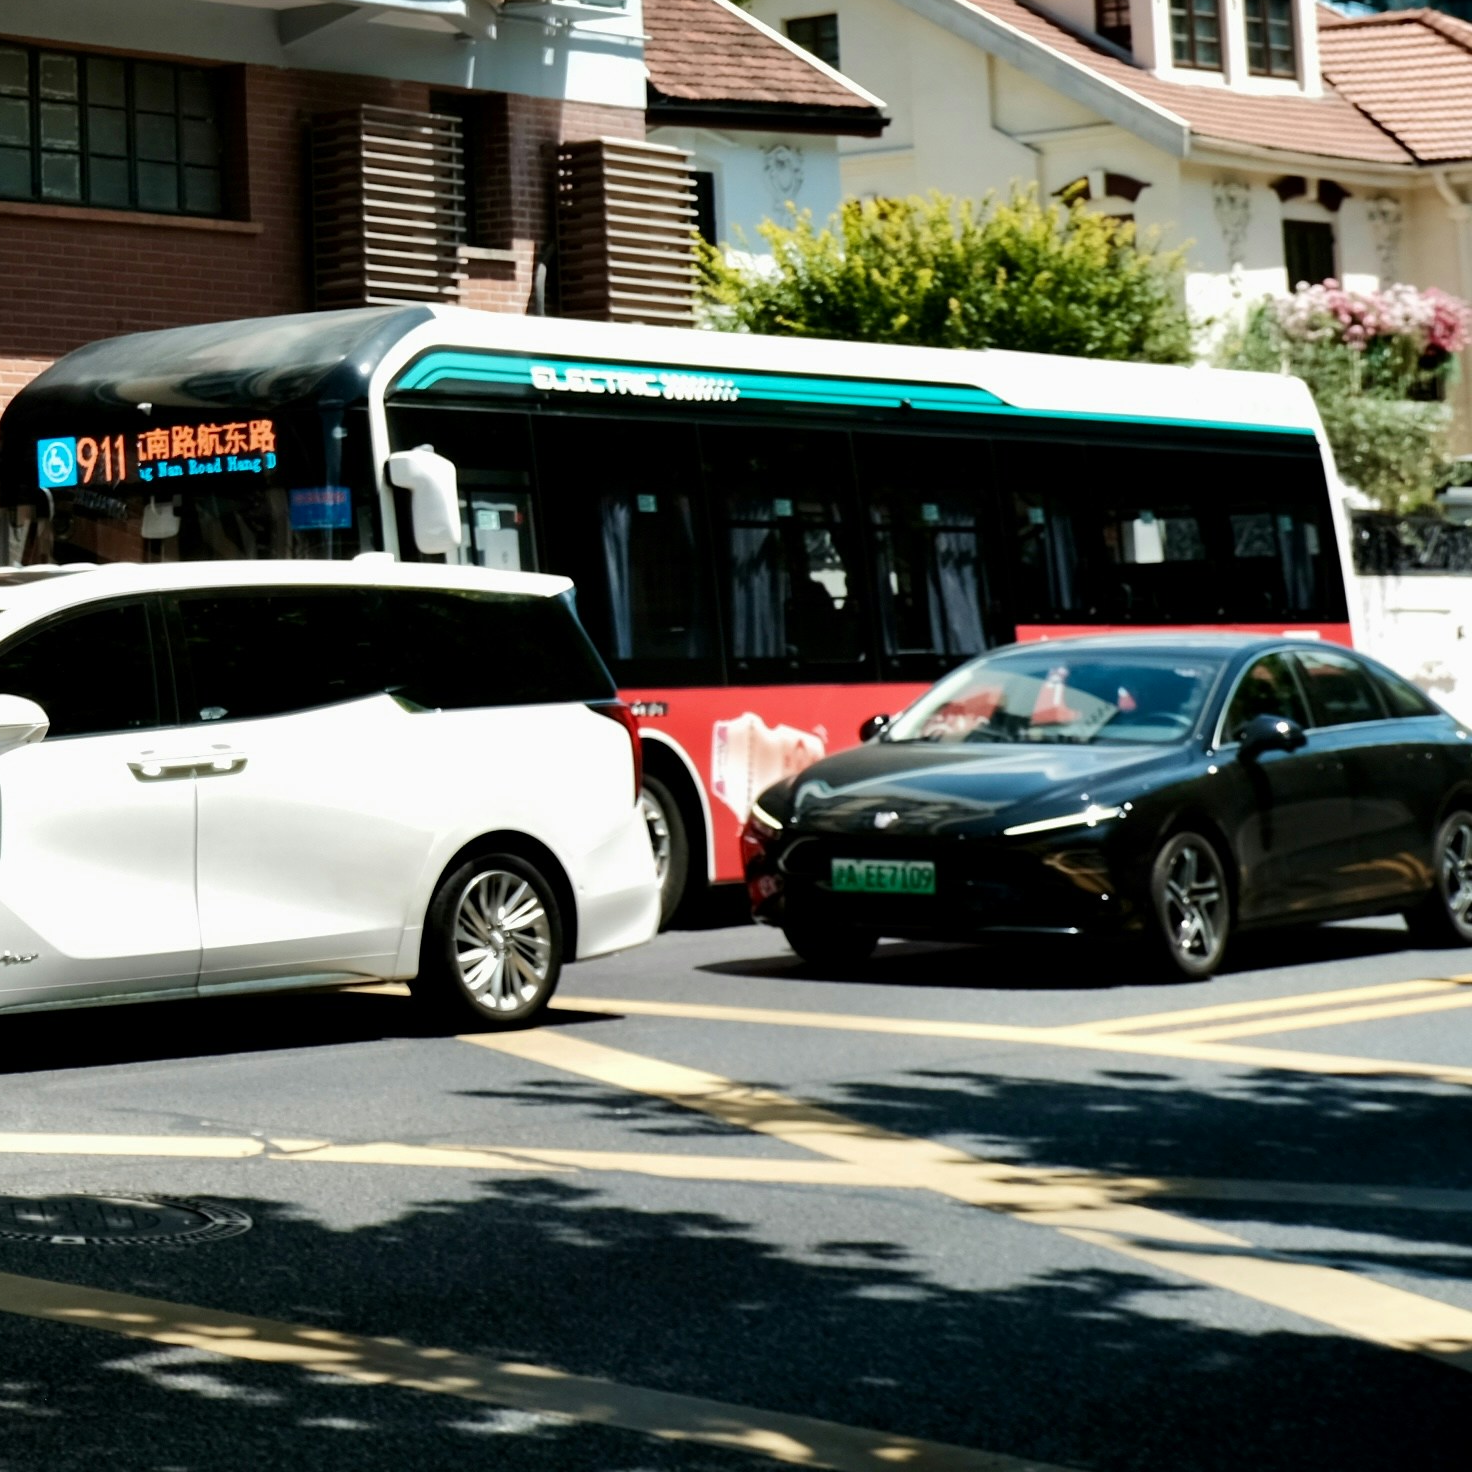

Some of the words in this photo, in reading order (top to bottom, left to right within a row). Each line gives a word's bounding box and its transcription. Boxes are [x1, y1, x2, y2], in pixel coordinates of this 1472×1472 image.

[531, 366, 660, 398] ELECTRIC
[76, 434, 126, 484] 911
[187, 459, 222, 475] Road
